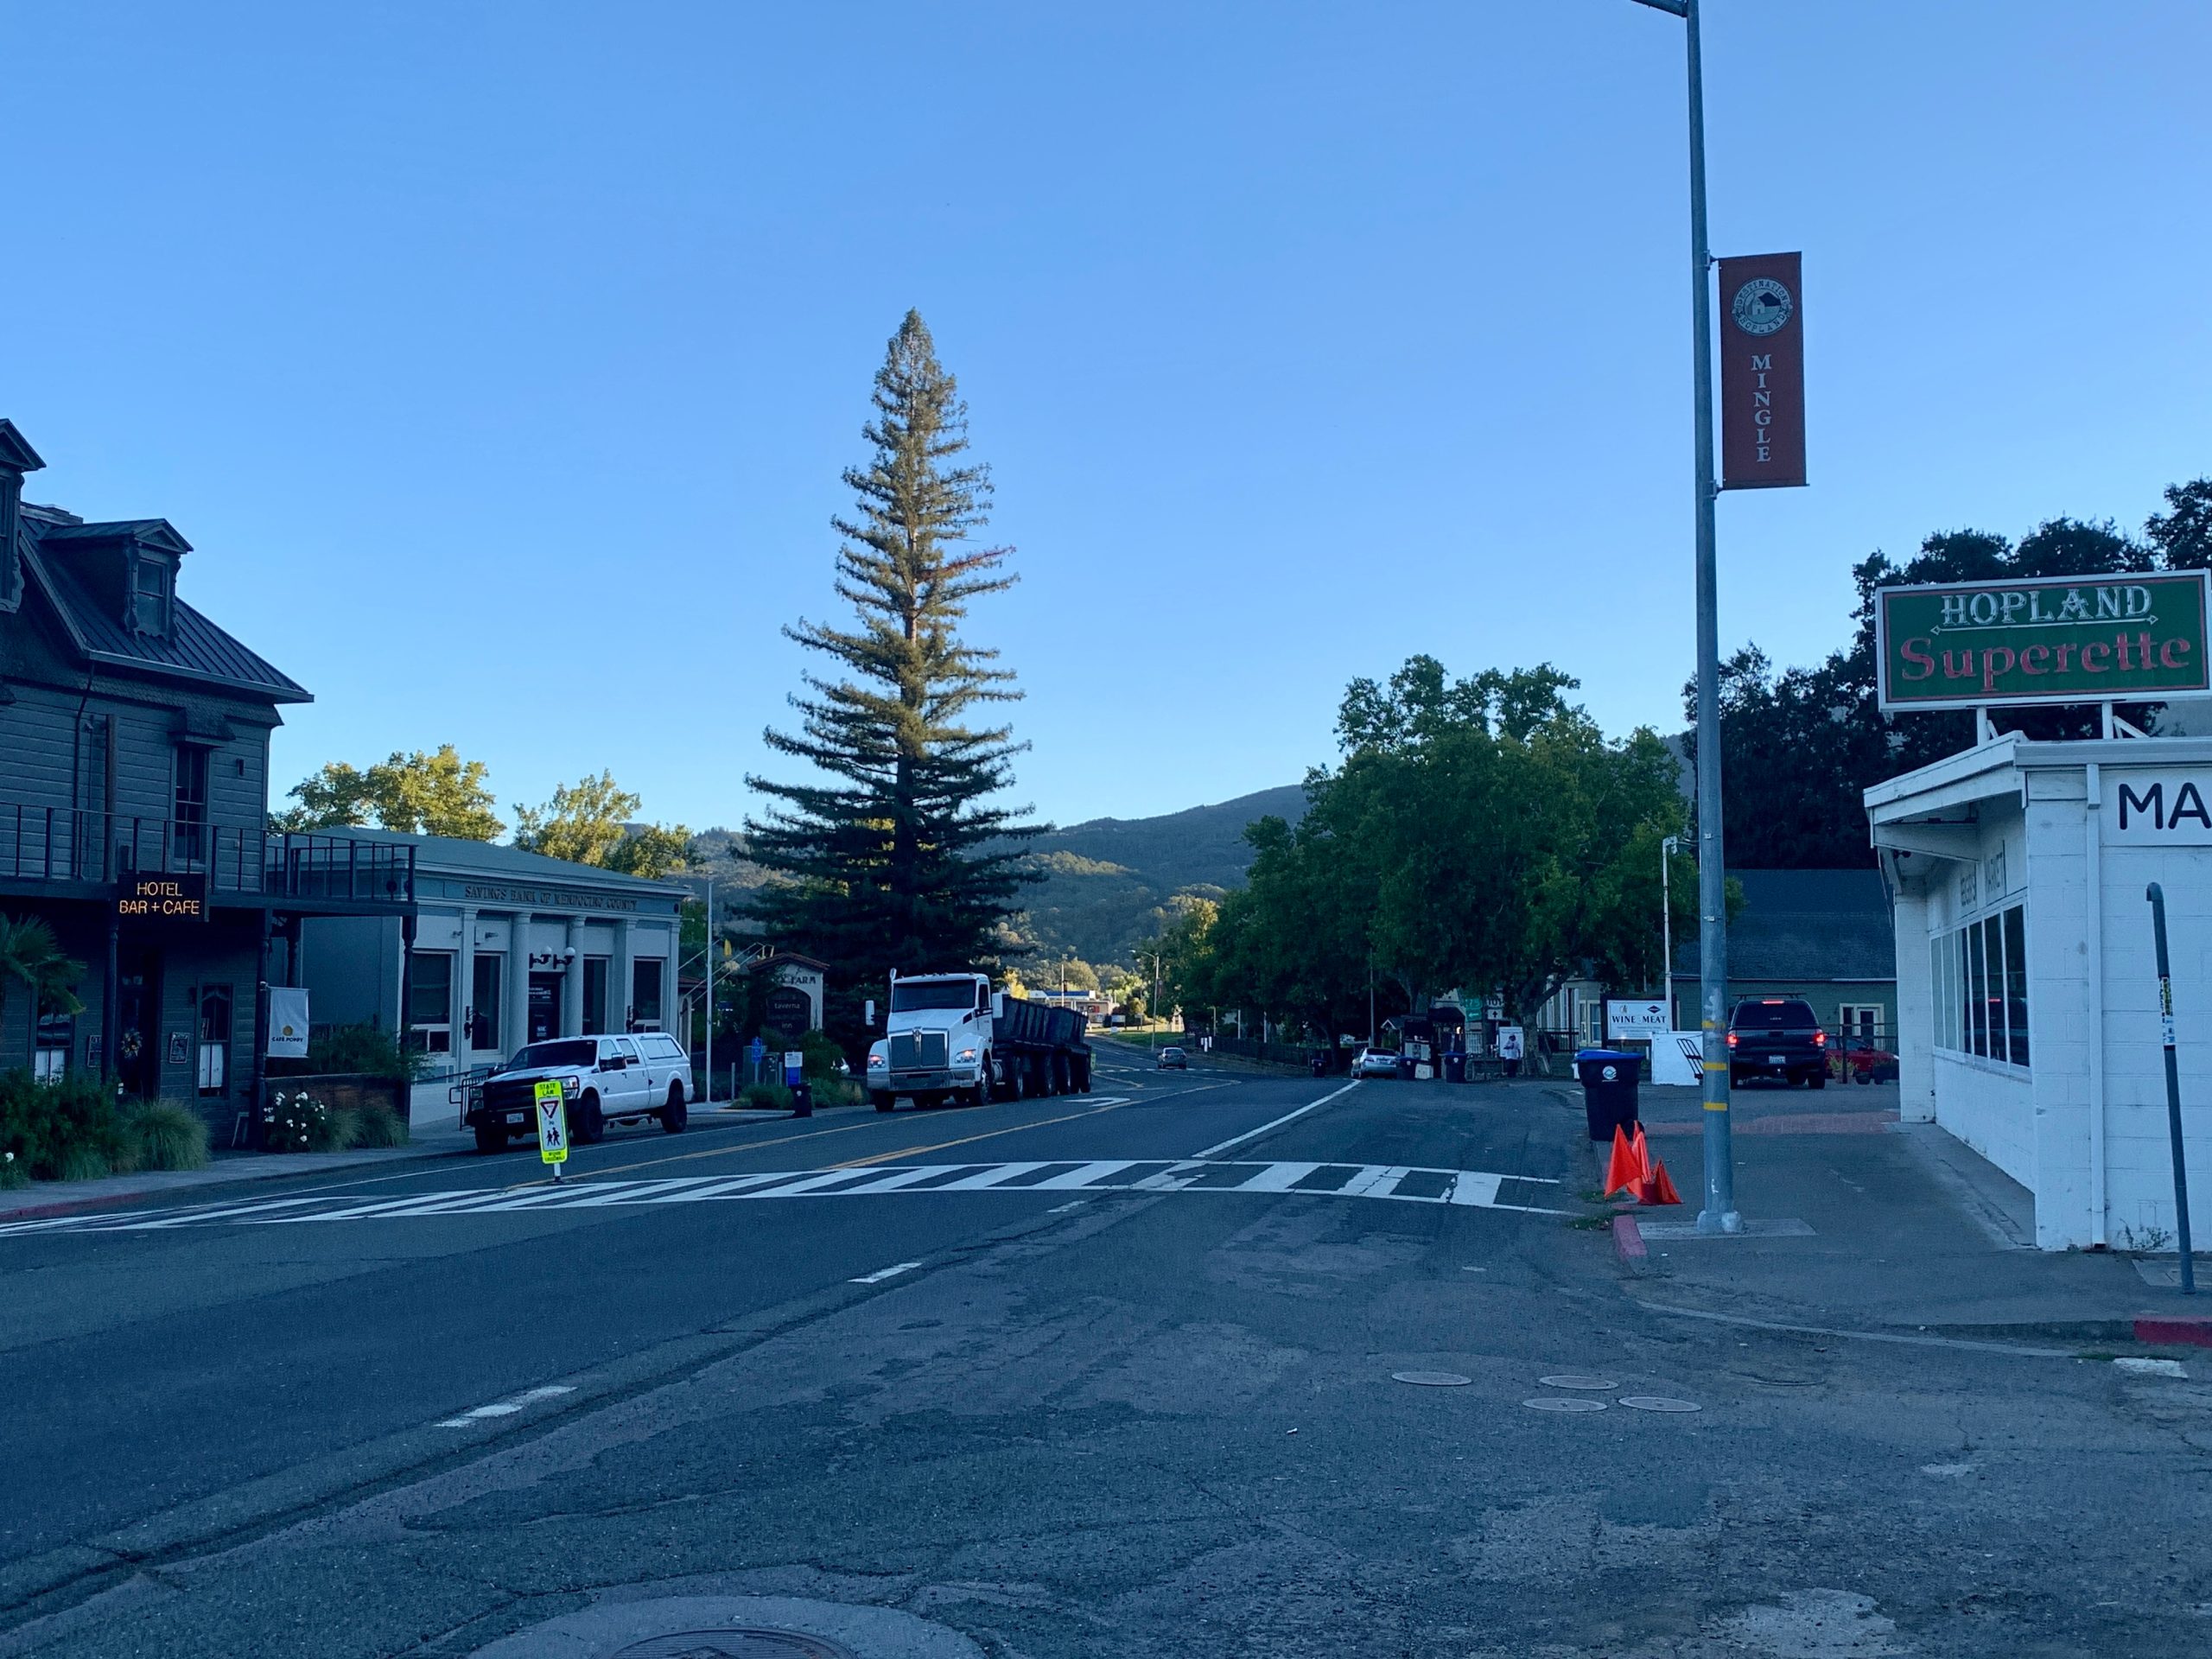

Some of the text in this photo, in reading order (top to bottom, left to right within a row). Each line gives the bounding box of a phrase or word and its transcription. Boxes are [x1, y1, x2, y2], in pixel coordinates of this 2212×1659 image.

[1735, 279, 1789, 306] DESTINATION
[1738, 312, 1788, 333] HOPLAND
[1751, 353, 1772, 462] MINGLE
[1941, 585, 2152, 626] HOPLAND
[1900, 632, 2192, 692] Superette
[137, 881, 183, 897] HOTEL
[465, 886, 507, 900] SAVINGS
[511, 889, 537, 904] BANK
[540, 892, 551, 905] OF
[607, 897, 638, 912] COUNTY
[119, 899, 148, 915] BAR
[162, 899, 200, 915] CAFE
[791, 976, 817, 985] FARM
[1642, 1015, 1666, 1024] MEAT
